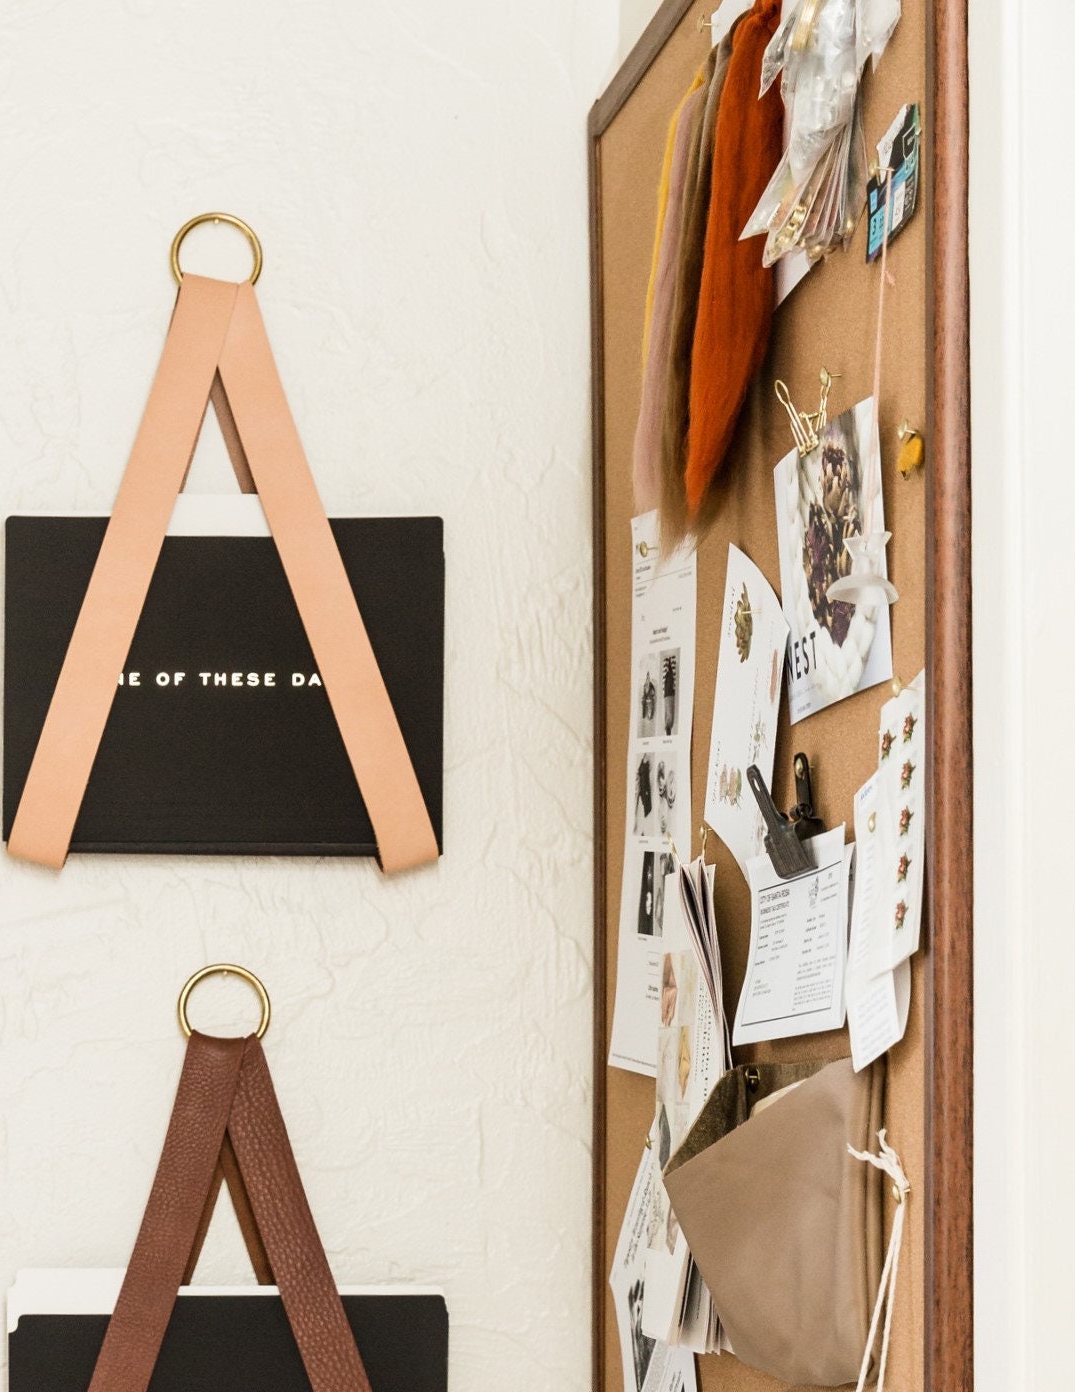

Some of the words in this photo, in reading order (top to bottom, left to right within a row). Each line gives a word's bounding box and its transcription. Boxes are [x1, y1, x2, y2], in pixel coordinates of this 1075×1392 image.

[155, 672, 186, 687] OF
[198, 672, 276, 687] THESE
[291, 672, 322, 687] DA
